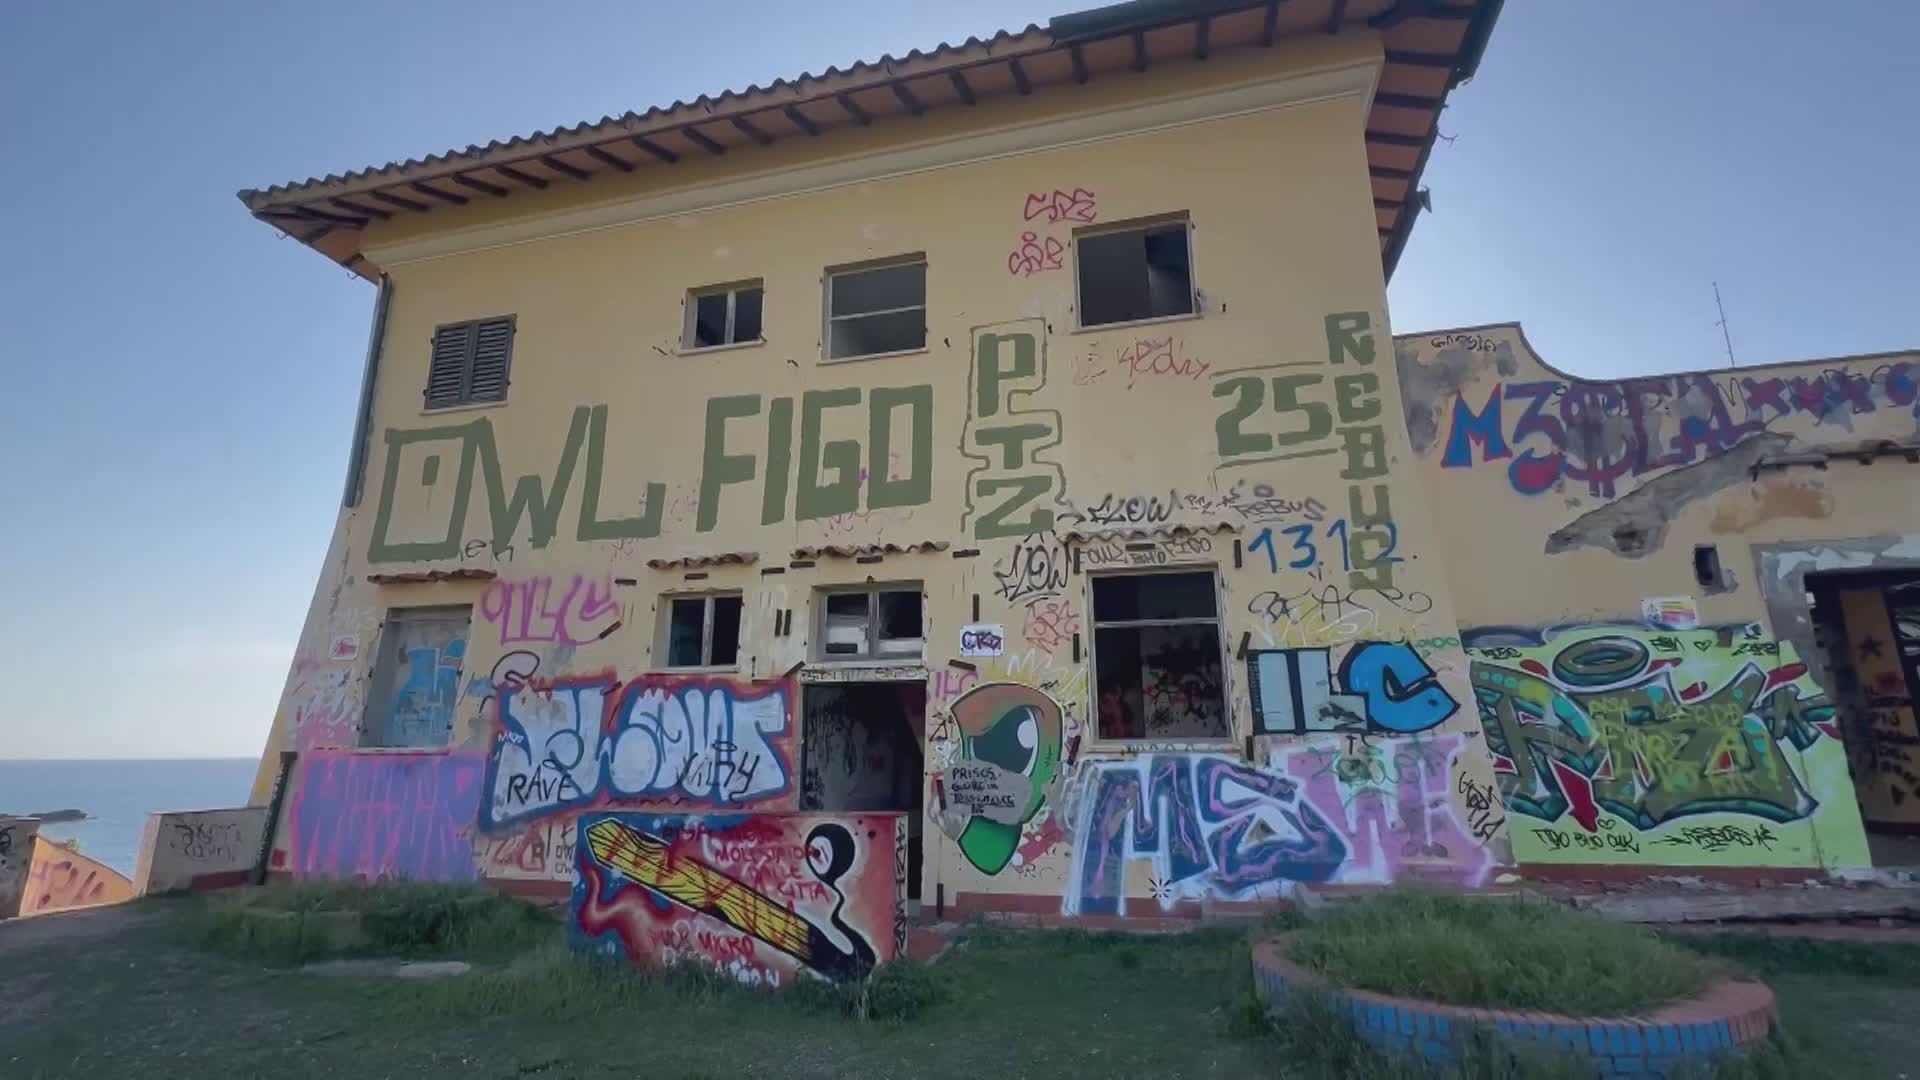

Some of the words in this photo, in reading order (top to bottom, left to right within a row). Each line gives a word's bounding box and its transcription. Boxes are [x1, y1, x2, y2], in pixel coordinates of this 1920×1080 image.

[1212, 373, 1333, 457] 25
[696, 384, 933, 533] FIGO
[1247, 518, 1405, 574] 1312
